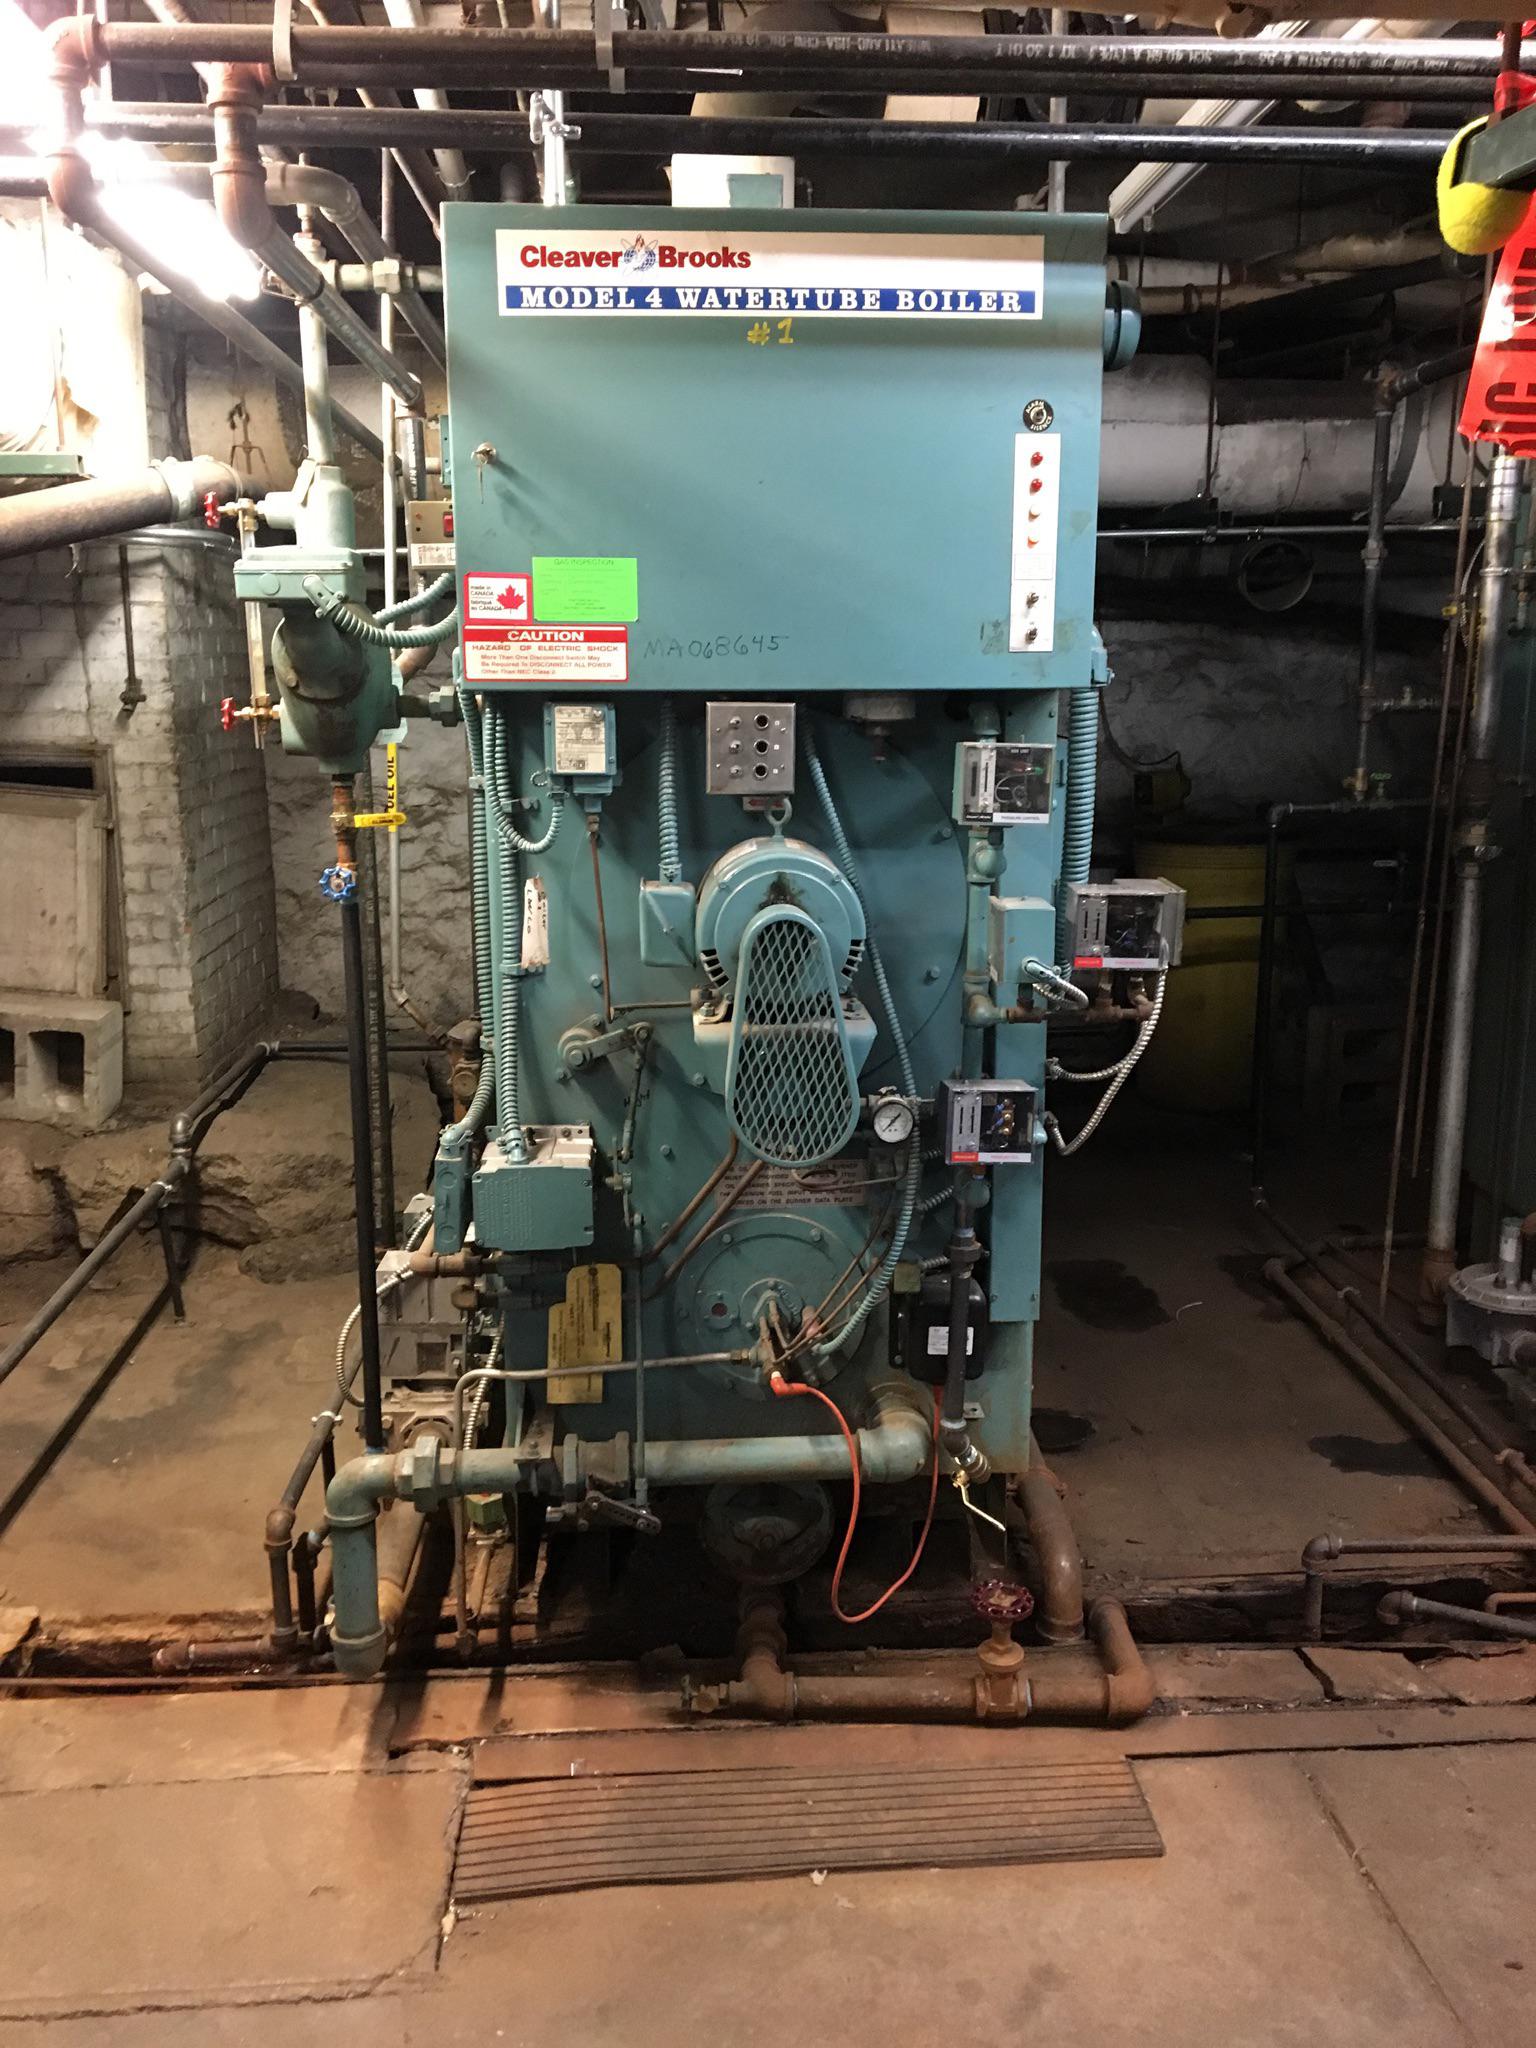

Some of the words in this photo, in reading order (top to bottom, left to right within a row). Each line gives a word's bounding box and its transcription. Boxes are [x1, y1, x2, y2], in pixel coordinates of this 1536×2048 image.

[520, 245, 622, 268] Cleaver
[658, 245, 751, 269] Brooks
[520, 287, 634, 309] MODEL
[645, 288, 662, 309] 4
[676, 288, 880, 310] WATERTUBE
[896, 290, 1021, 312] BOILER
[507, 630, 585, 642] CAUTION
[644, 634, 789, 659] MA068645
[387, 756, 395, 779] OIL
